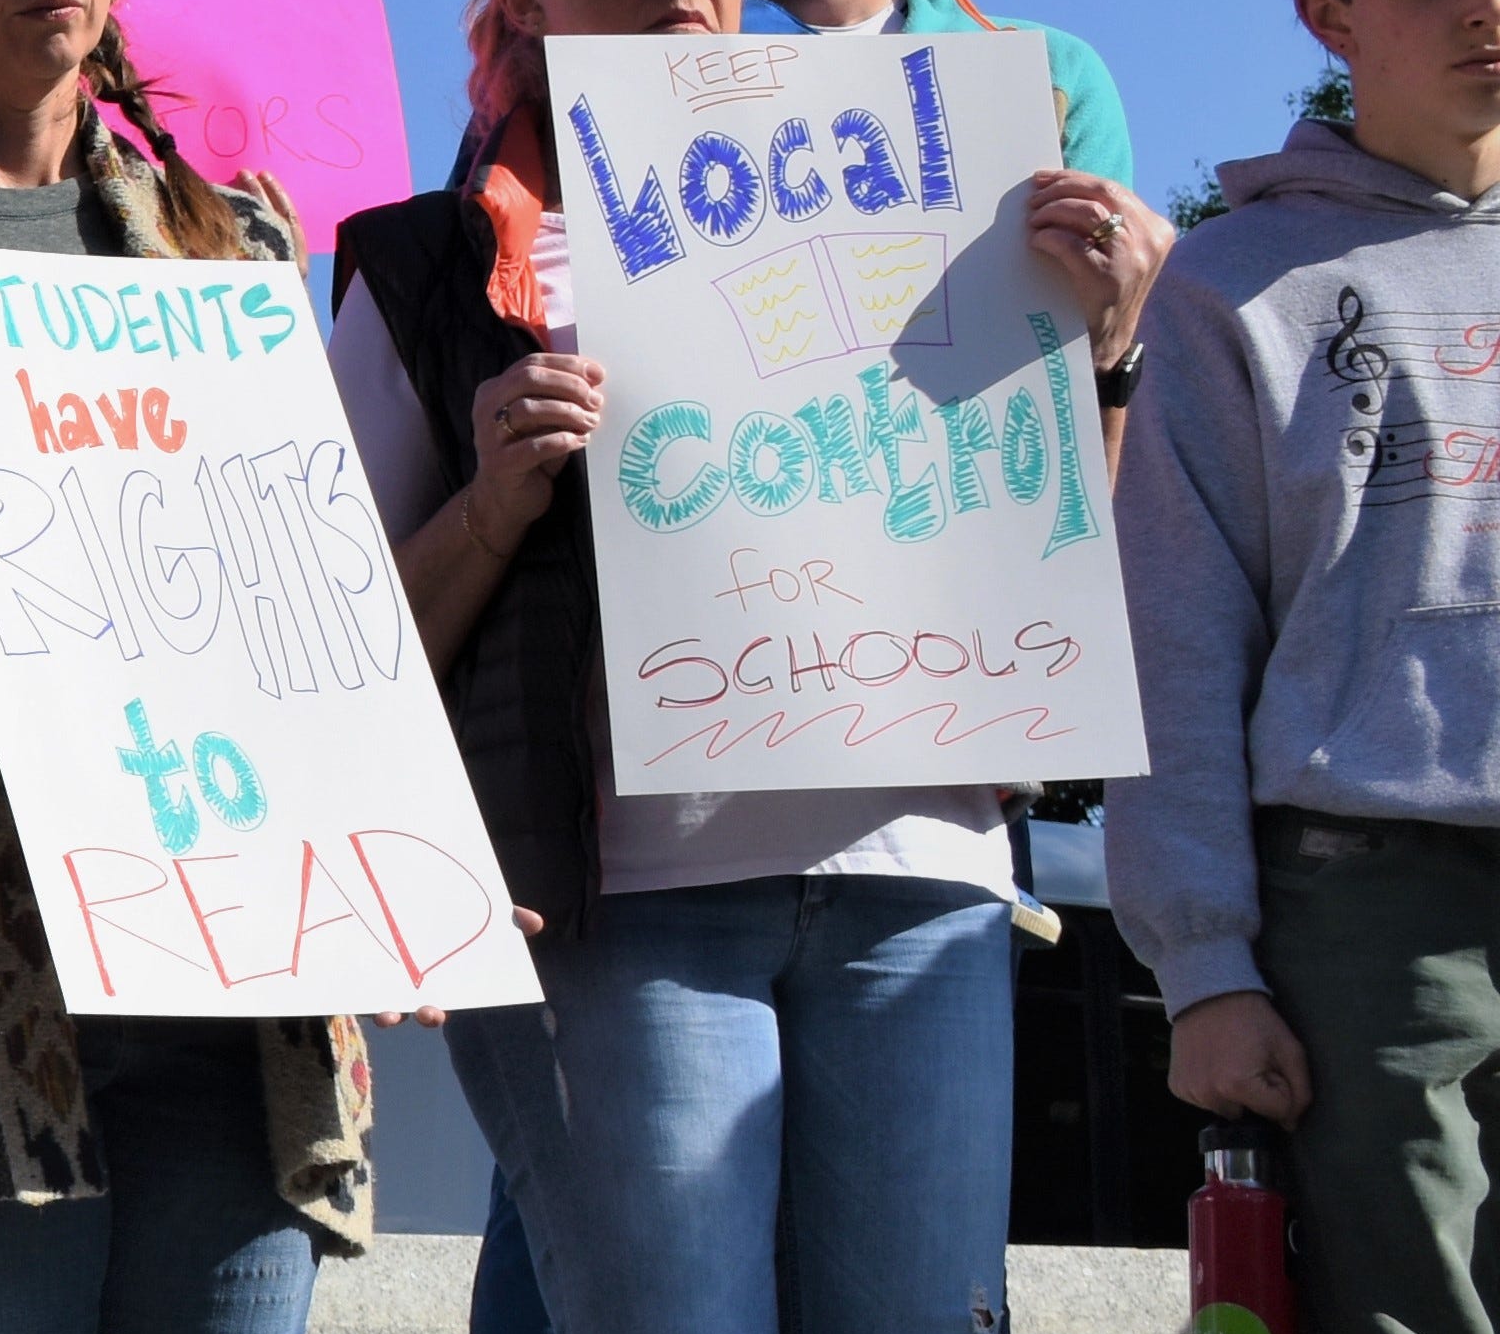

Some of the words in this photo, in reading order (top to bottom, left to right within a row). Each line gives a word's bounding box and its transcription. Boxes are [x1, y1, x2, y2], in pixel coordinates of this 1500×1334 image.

[663, 43, 800, 99] KEEP
[567, 45, 963, 285] Local
[14, 367, 188, 455] have
[637, 620, 1083, 709] SCHOOLS
[114, 696, 268, 856] to
[63, 828, 493, 997] READ
